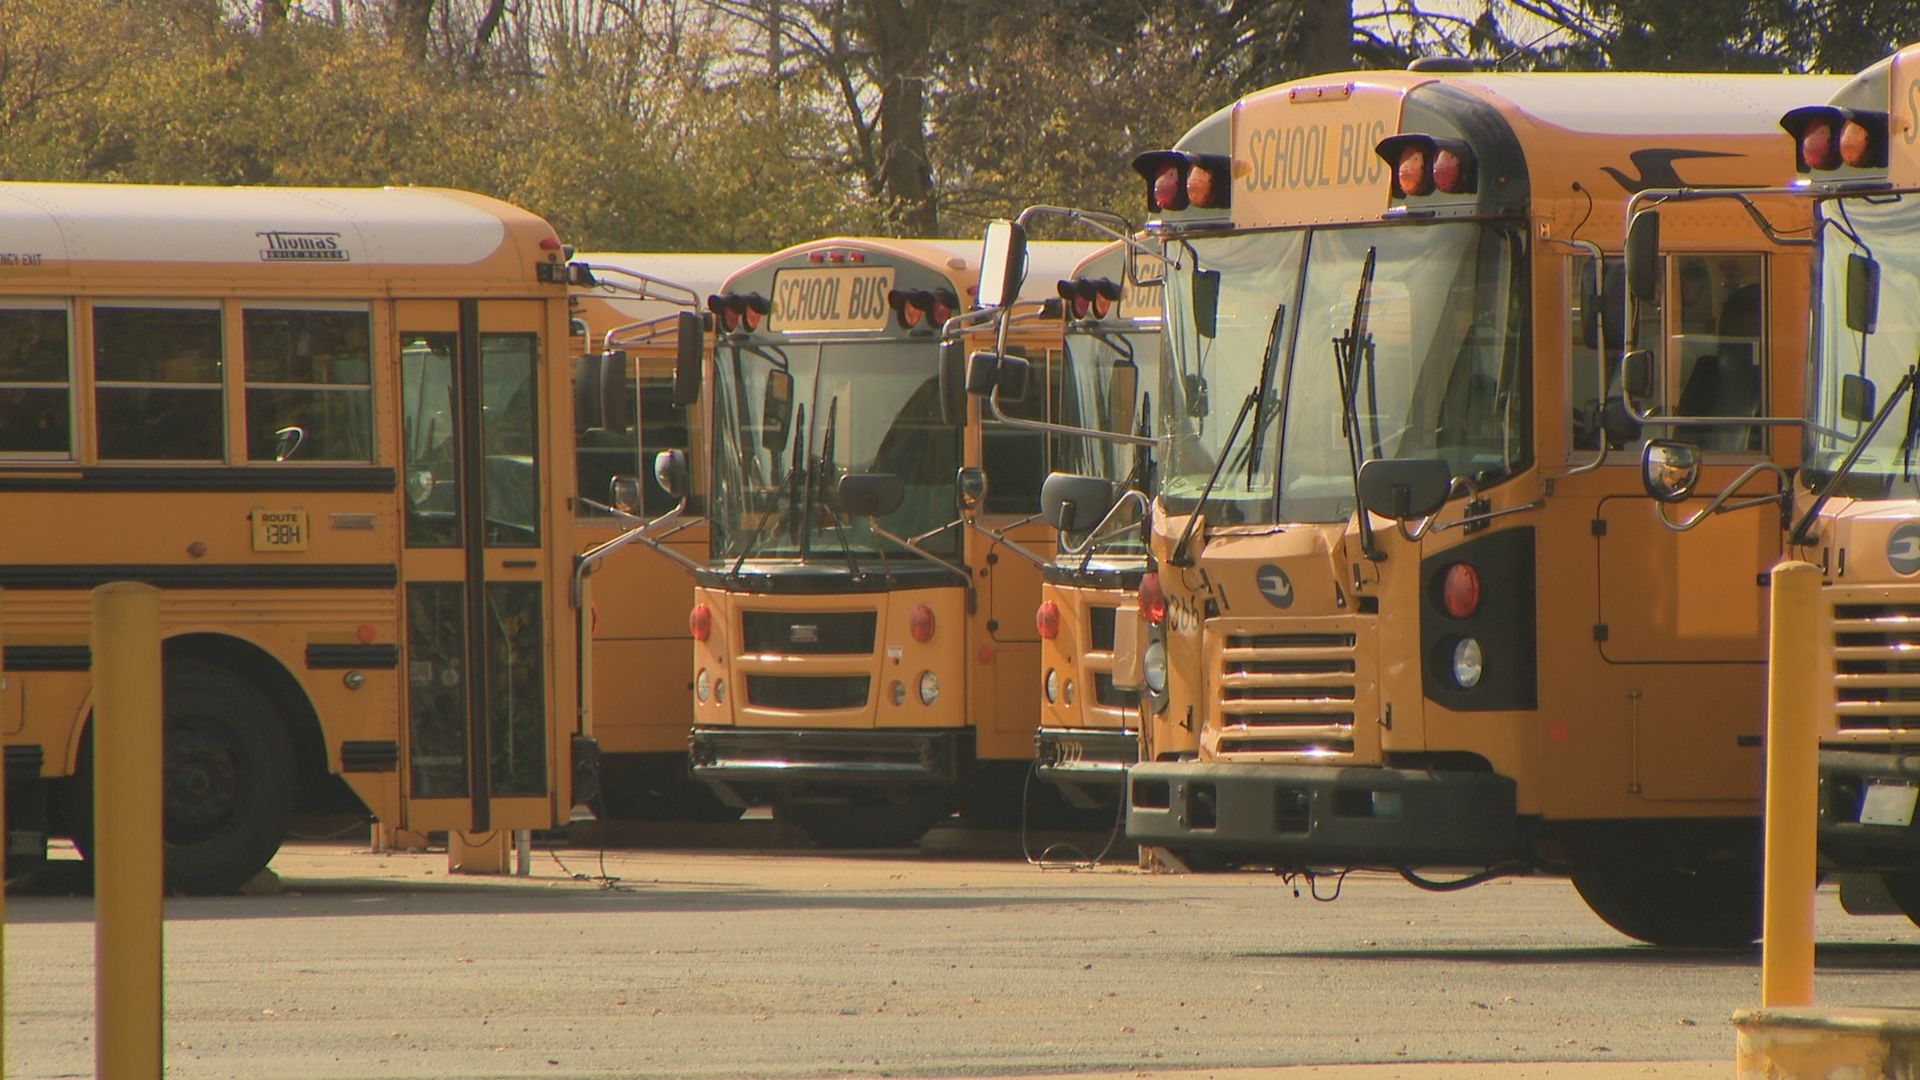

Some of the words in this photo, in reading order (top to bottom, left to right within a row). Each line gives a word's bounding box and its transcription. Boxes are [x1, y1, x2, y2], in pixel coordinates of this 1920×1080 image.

[1246, 124, 1330, 192] SCHOOL
[1337, 120, 1385, 185] BUS
[256, 231, 341, 250] Thomas
[775, 277, 841, 321] SCHOOL
[848, 276, 888, 320] BUS
[262, 514, 297, 522] ROUTE
